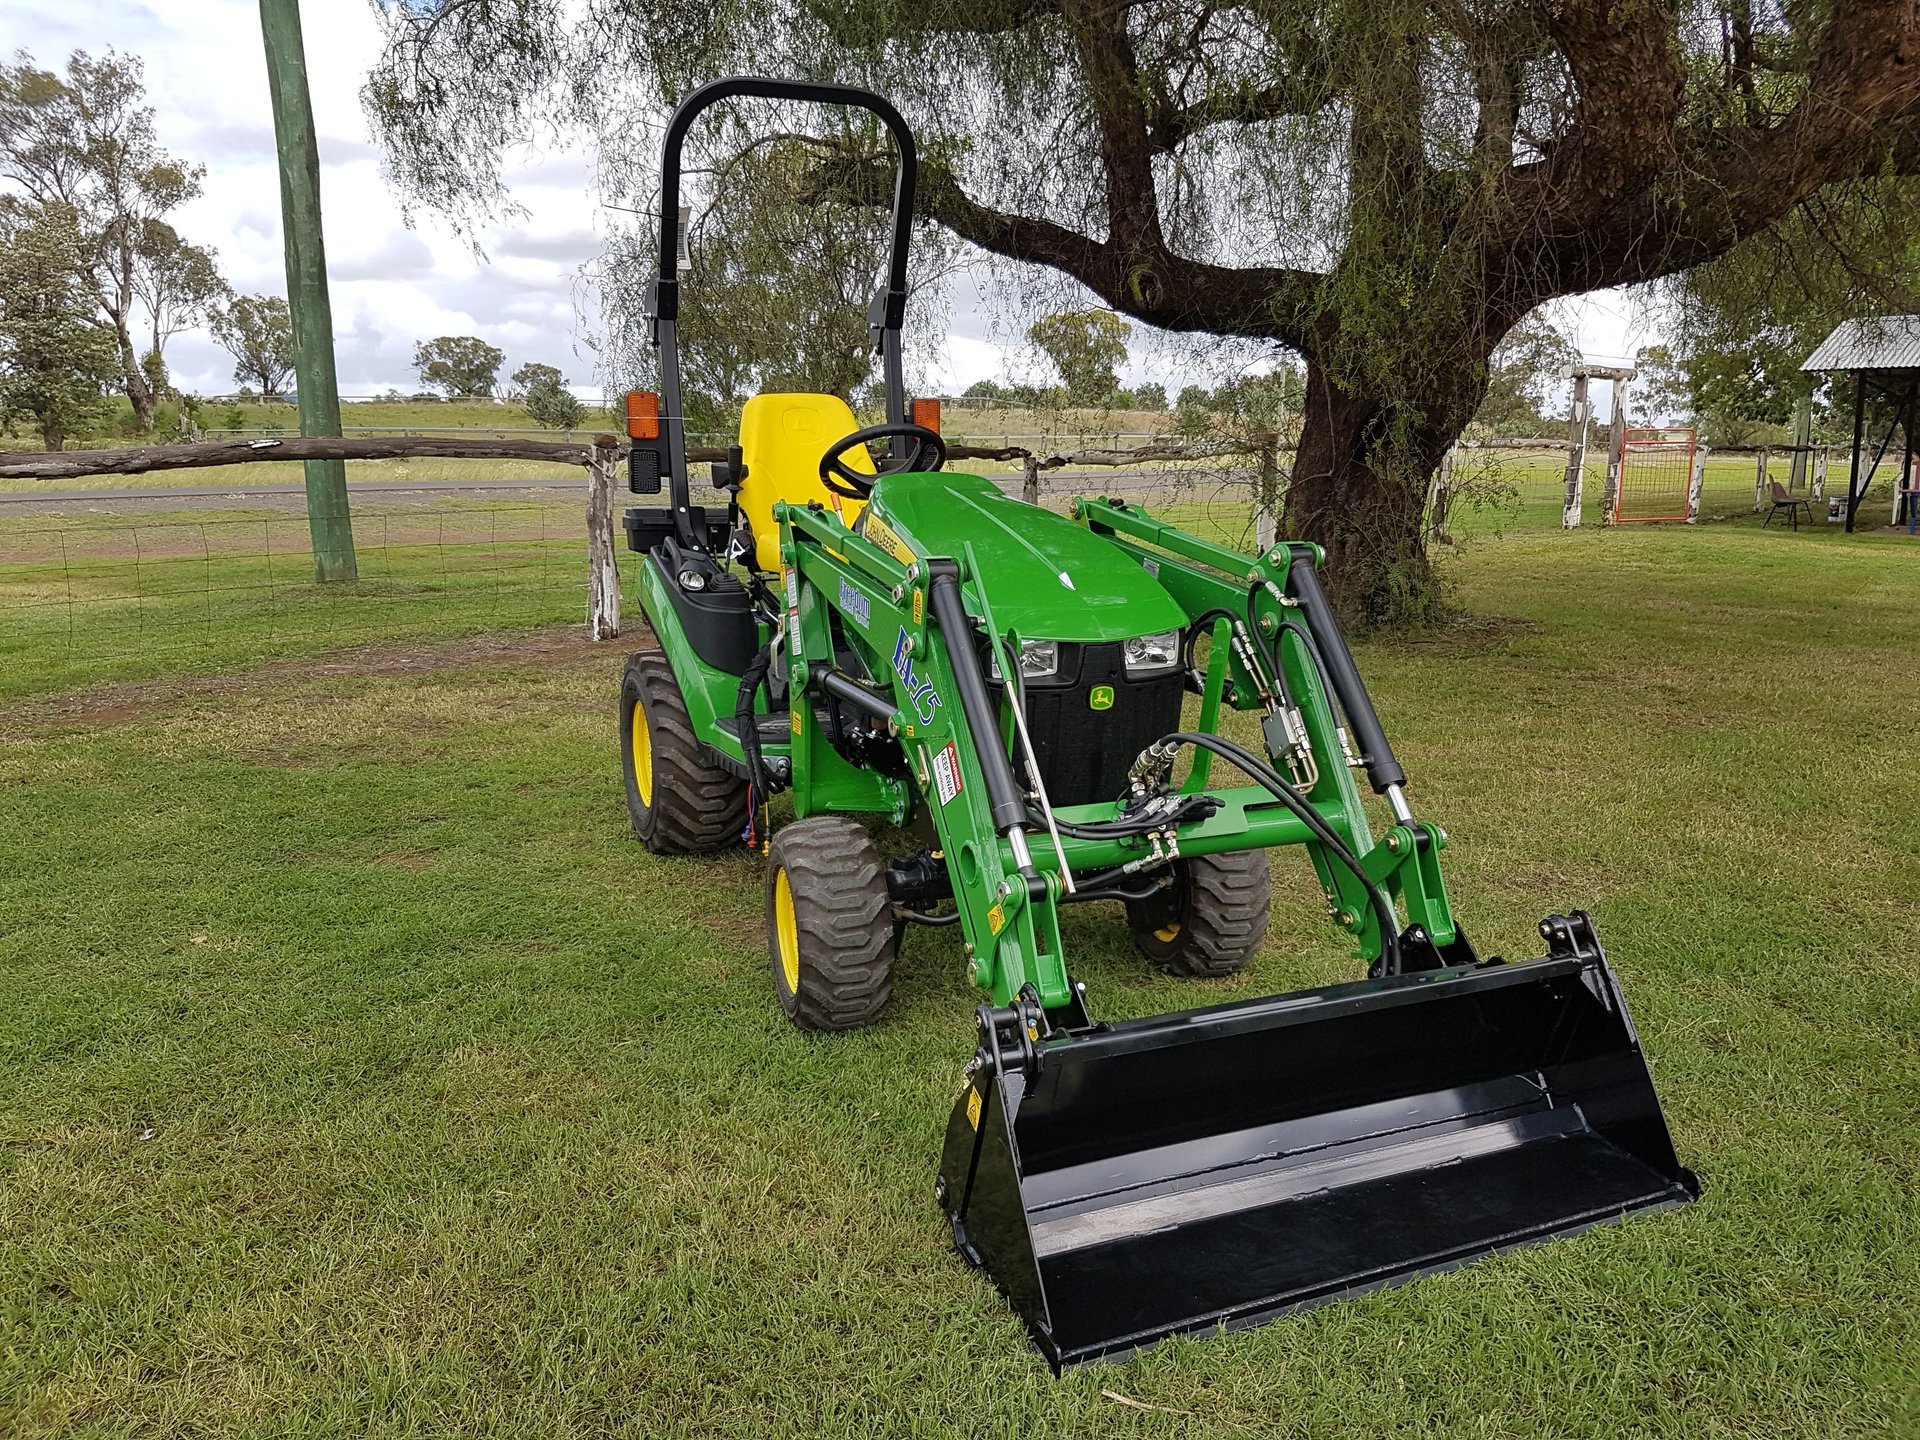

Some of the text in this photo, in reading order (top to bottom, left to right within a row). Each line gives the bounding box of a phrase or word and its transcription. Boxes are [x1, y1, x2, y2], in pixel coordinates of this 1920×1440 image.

[879, 528, 898, 555] DEERE
[839, 576, 871, 620] Freedom
[940, 751, 955, 797] KEEP AWAY
[950, 756, 962, 791] WARNING
